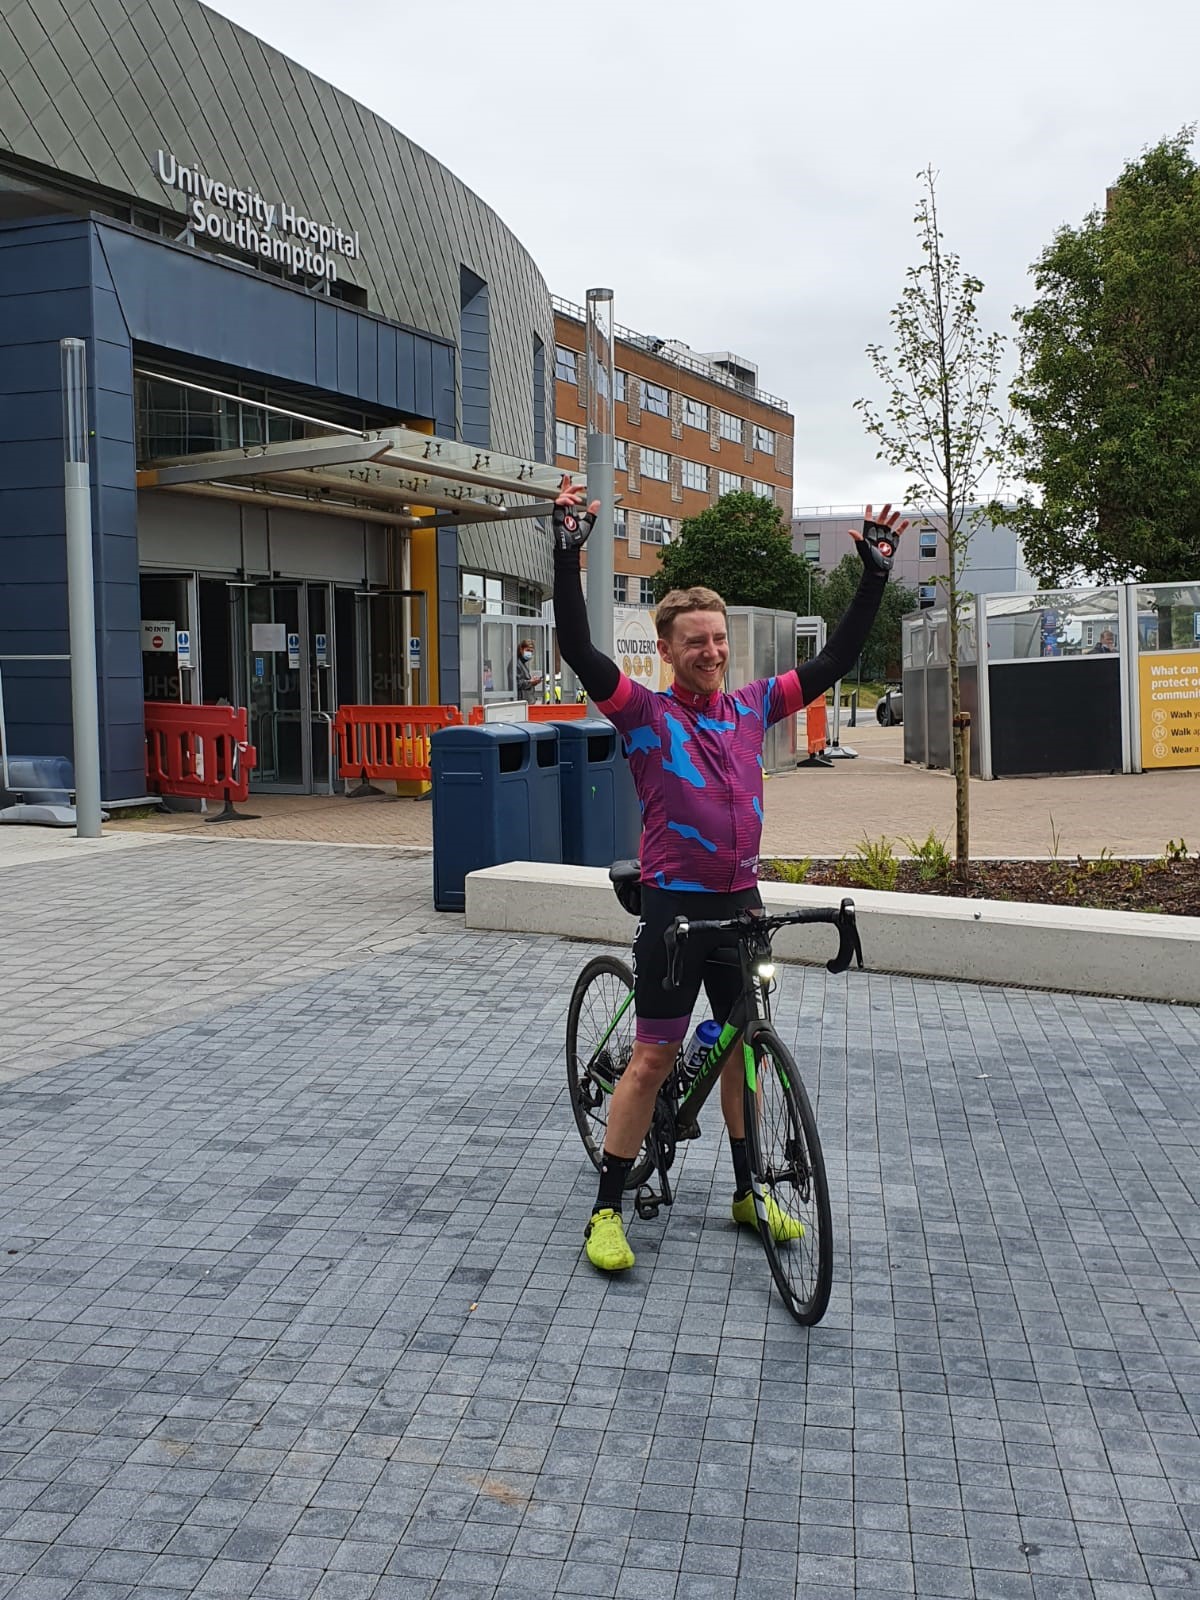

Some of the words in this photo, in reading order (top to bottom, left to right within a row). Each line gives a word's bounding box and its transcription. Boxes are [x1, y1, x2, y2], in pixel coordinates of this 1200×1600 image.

[157, 149, 275, 232] University
[281, 202, 360, 260] Hospital
[191, 199, 337, 281] Southampton
[617, 639, 638, 654] COVID
[639, 640, 656, 655] ZERO
[1151, 665, 1178, 676] What
[1180, 666, 1198, 674] can
[1152, 677, 1188, 690] protect
[1170, 709, 1192, 719] Wash
[1171, 727, 1191, 737] Walk
[1171, 745, 1193, 754] Wear
